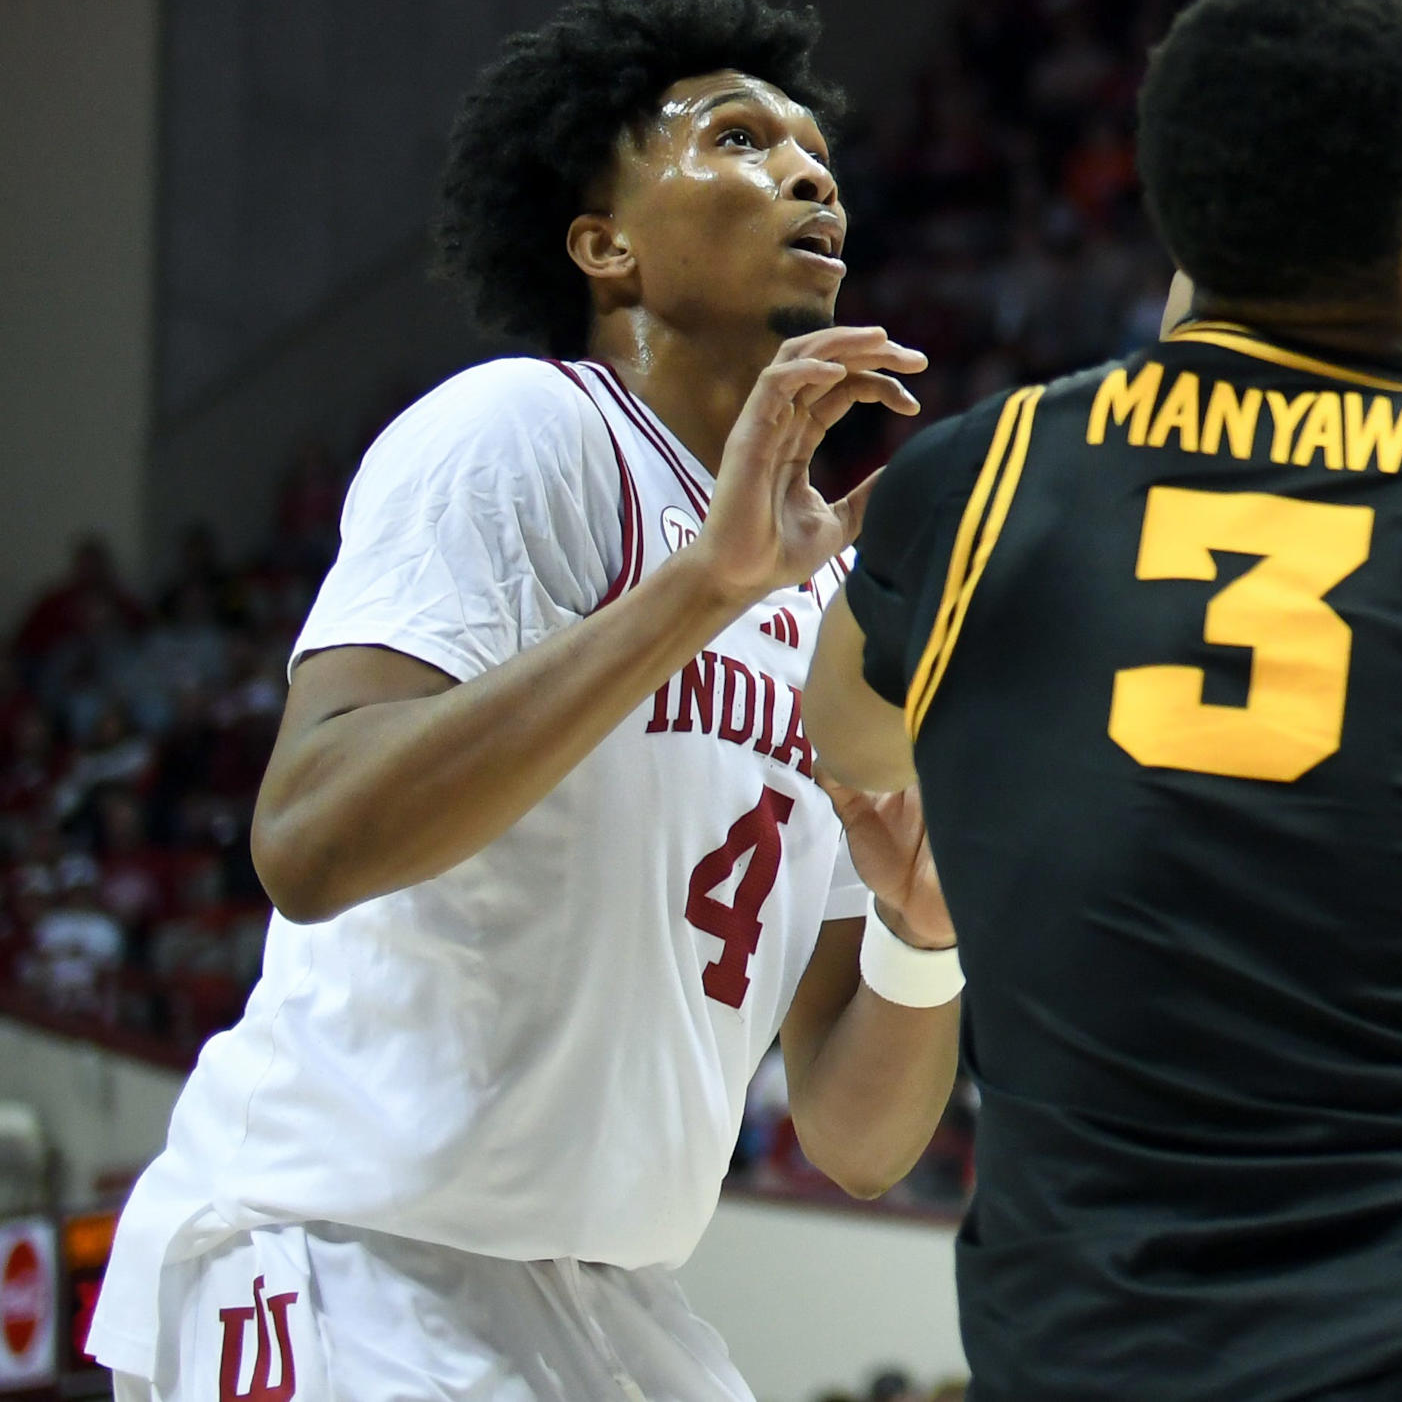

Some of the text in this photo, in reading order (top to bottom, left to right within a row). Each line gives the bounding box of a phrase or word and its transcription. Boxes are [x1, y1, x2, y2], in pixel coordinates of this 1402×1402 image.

[645, 650, 814, 780] INDIA
[1108, 486, 1375, 783] 3
[685, 783, 796, 1010] 4
